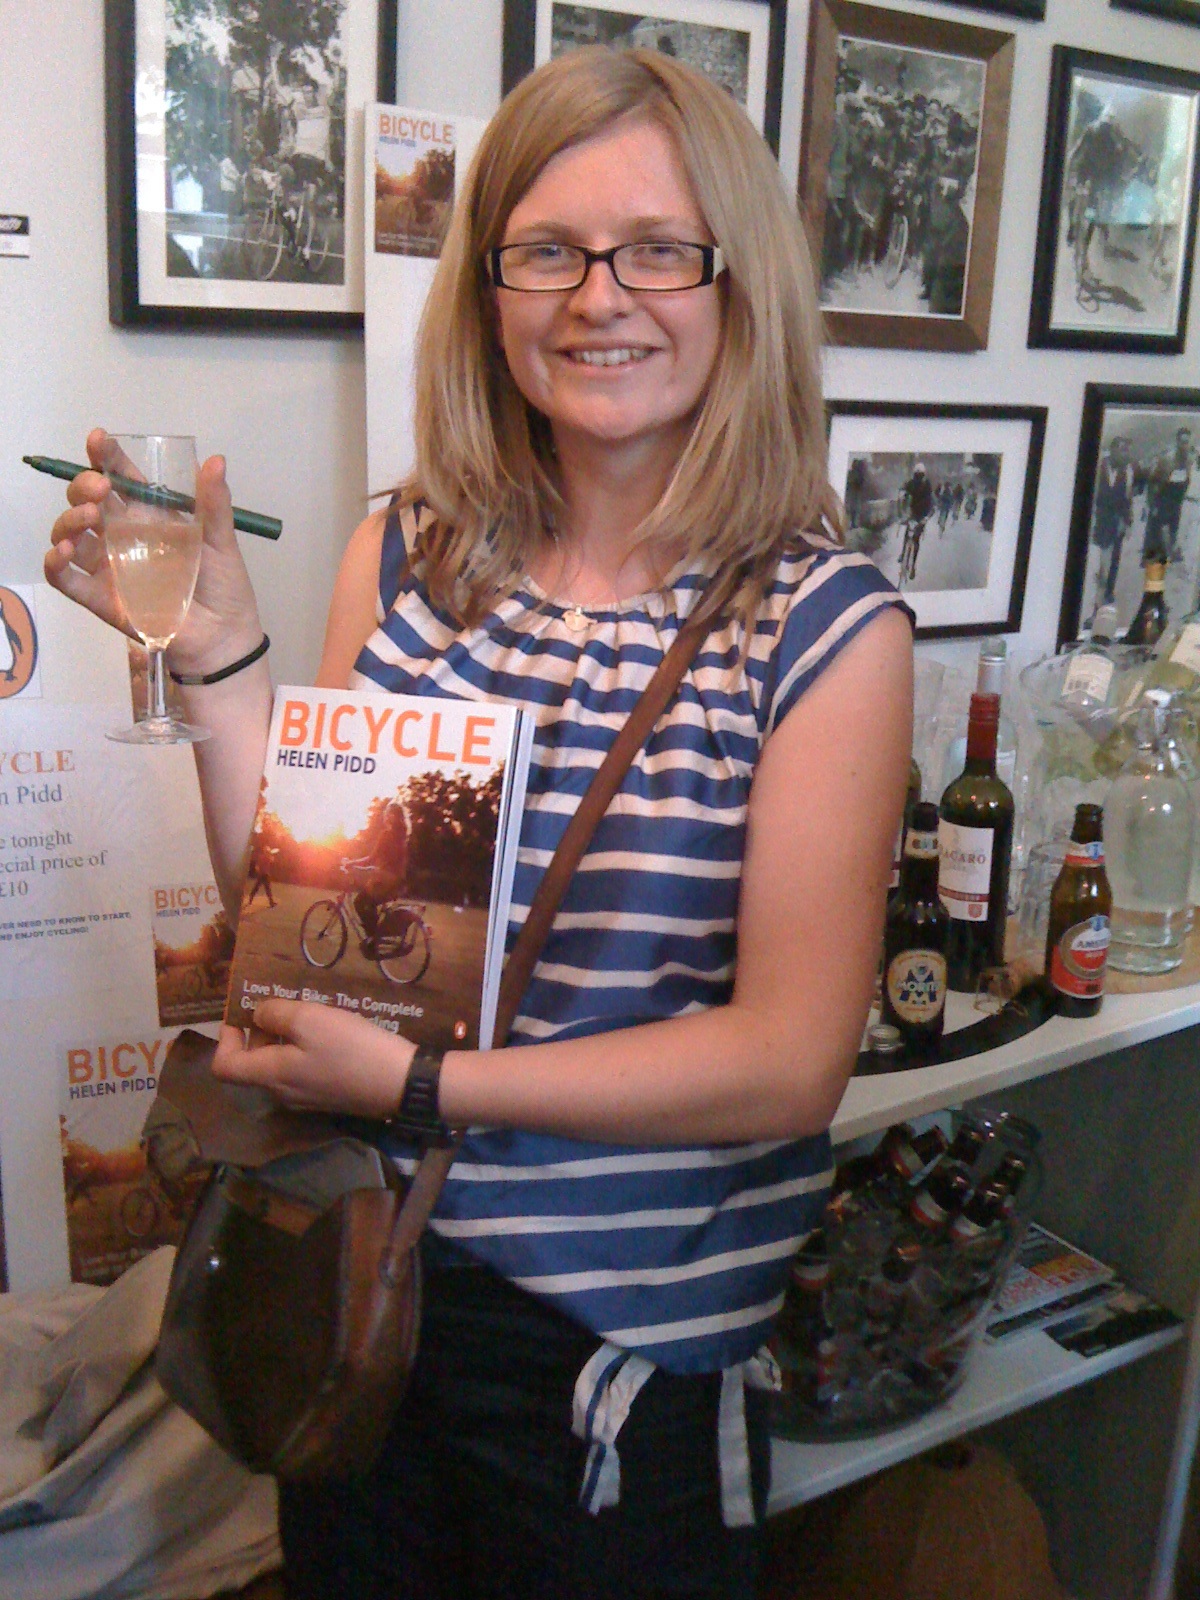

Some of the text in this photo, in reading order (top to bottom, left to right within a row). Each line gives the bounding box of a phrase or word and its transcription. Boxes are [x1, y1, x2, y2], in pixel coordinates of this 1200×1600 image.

[379, 113, 454, 145] BICYCLE
[279, 700, 496, 765] BICYCLE
[277, 749, 377, 774] HELEN PIDD
[17, 784, 62, 804] Pidd
[12, 830, 72, 850] tonight
[41, 855, 83, 874] price
[88, 850, 108, 866] of
[154, 885, 218, 910] BICYC
[44, 917, 56, 926] TO
[58, 915, 86, 925] KNOW
[88, 913, 100, 922] TO
[15, 930, 44, 940] ENJOY
[243, 979, 270, 996] Love
[271, 983, 299, 999] Your
[335, 992, 360, 1010] The
[361, 996, 424, 1018] Complete
[67, 1039, 174, 1084] BICY
[68, 1076, 157, 1100] HELEN PIDD
